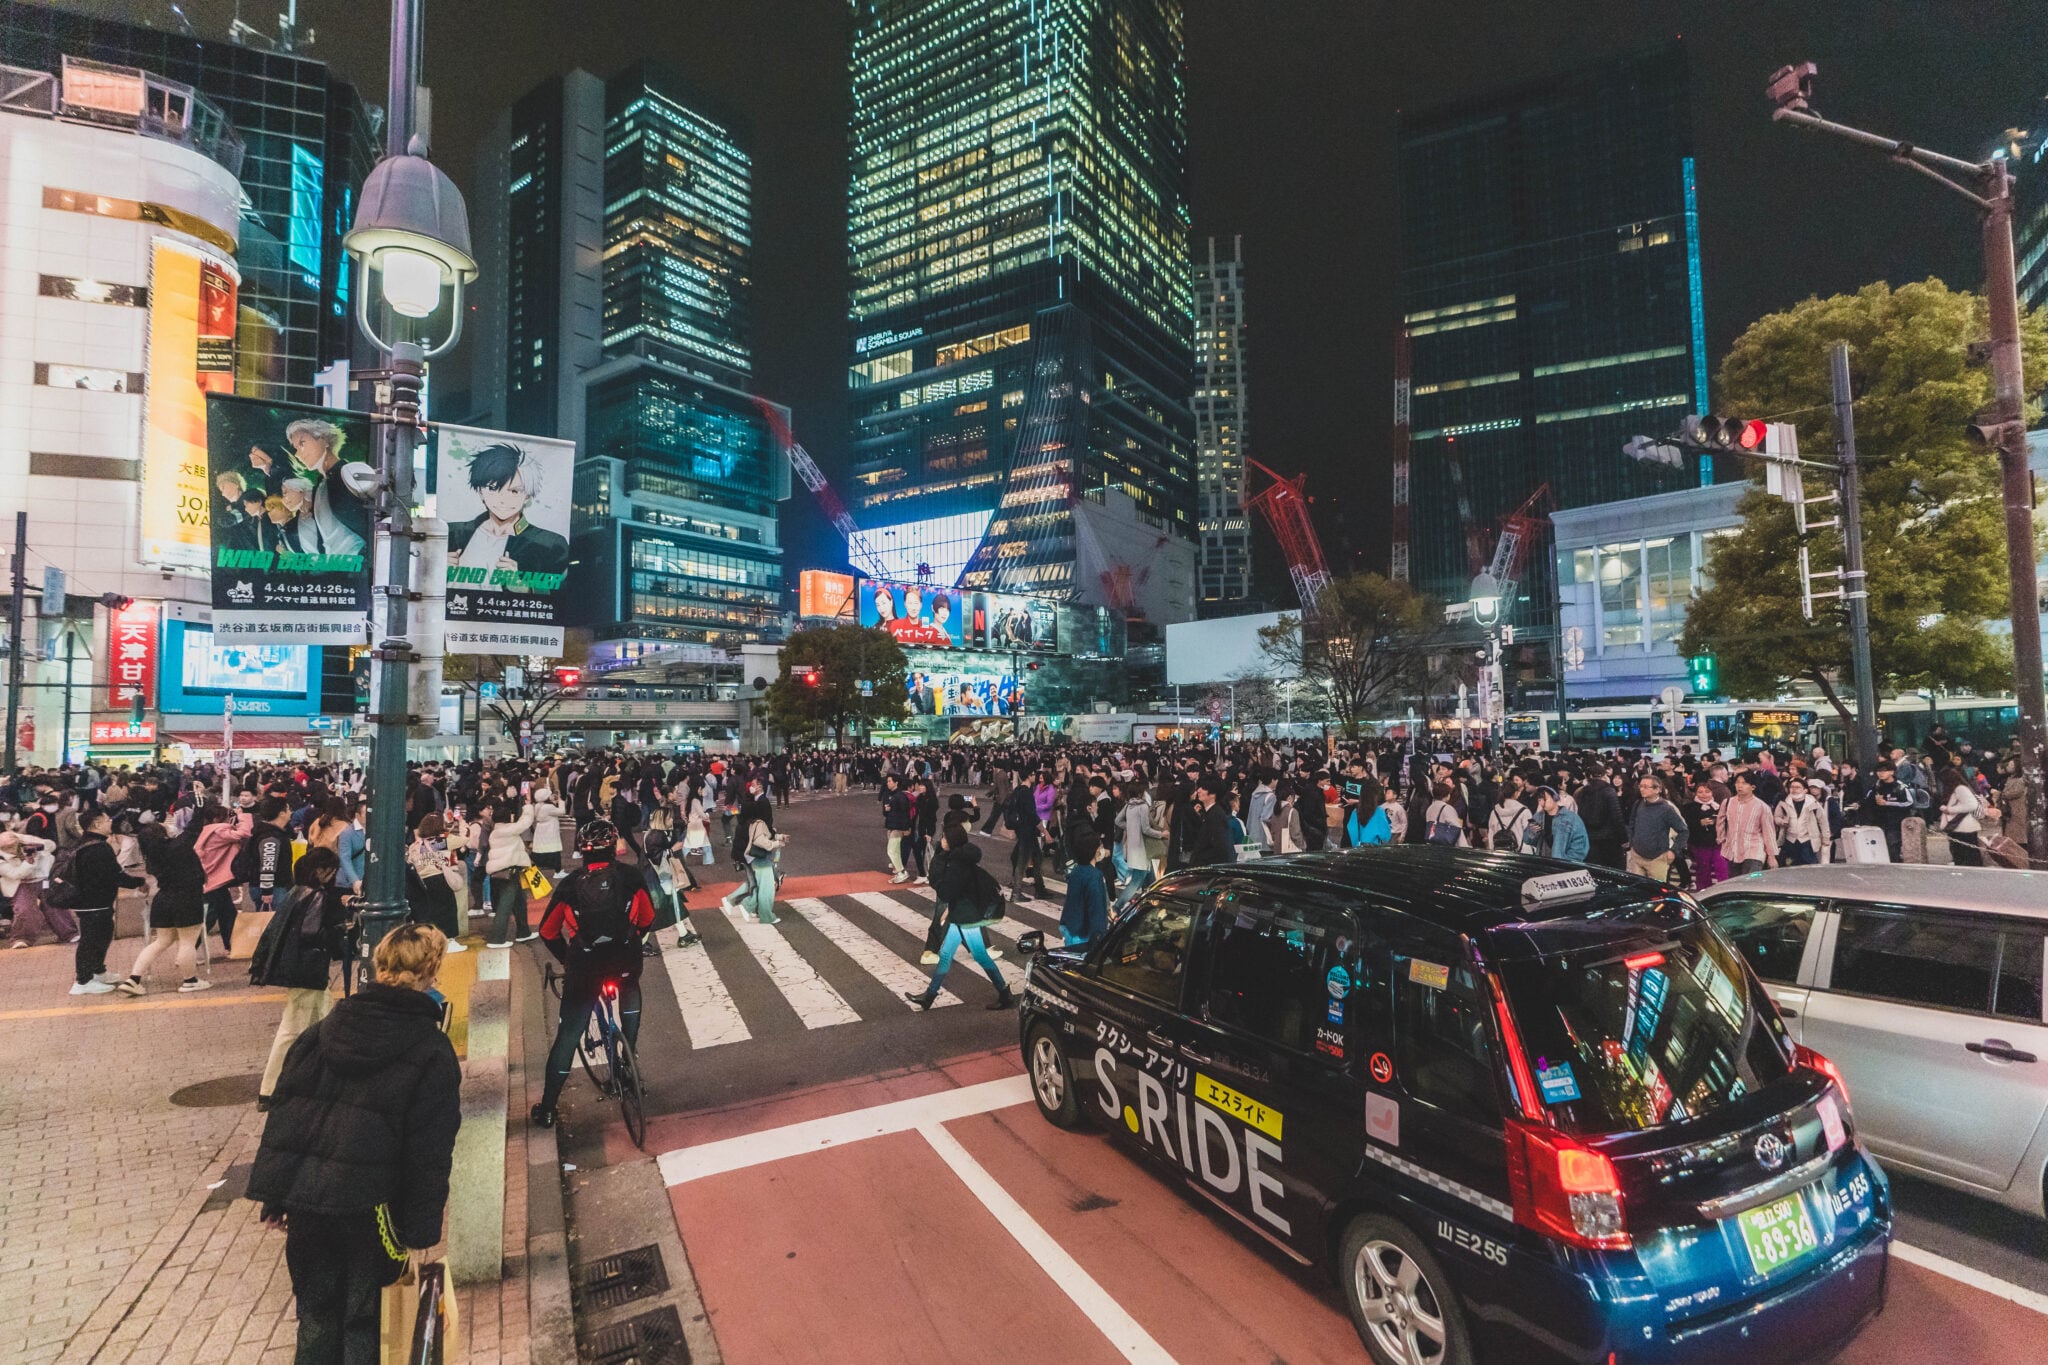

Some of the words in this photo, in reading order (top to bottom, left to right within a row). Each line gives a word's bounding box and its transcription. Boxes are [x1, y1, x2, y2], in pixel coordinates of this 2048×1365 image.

[868, 329, 893, 343] SHIBUYA
[868, 334, 898, 350] SCRAMBLE
[899, 327, 923, 341] SQUARE
[217, 546, 274, 571] WIND
[277, 550, 364, 573] BREAKER
[489, 568, 562, 590] BREAKER
[264, 595, 356, 605] アベマで最速無料配信
[477, 608, 553, 620] アベマで最速無料配信
[975, 609, 985, 631] N
[219, 623, 362, 633] 渋谷道玄坂商店街振興組合
[447, 633, 559, 646] 谷道玄坂商店街振興組合
[585, 703, 668, 715] 渋谷駅
[262, 842, 276, 871] COURSE
[1317, 1027, 1344, 1046] カードOK
[1097, 1020, 1188, 1088] タクシーアプリ
[1208, 1084, 1266, 1125] エスライド
[1095, 1048, 1291, 1237] S.RIDE
[1438, 1220, 1508, 1266] 山三255
